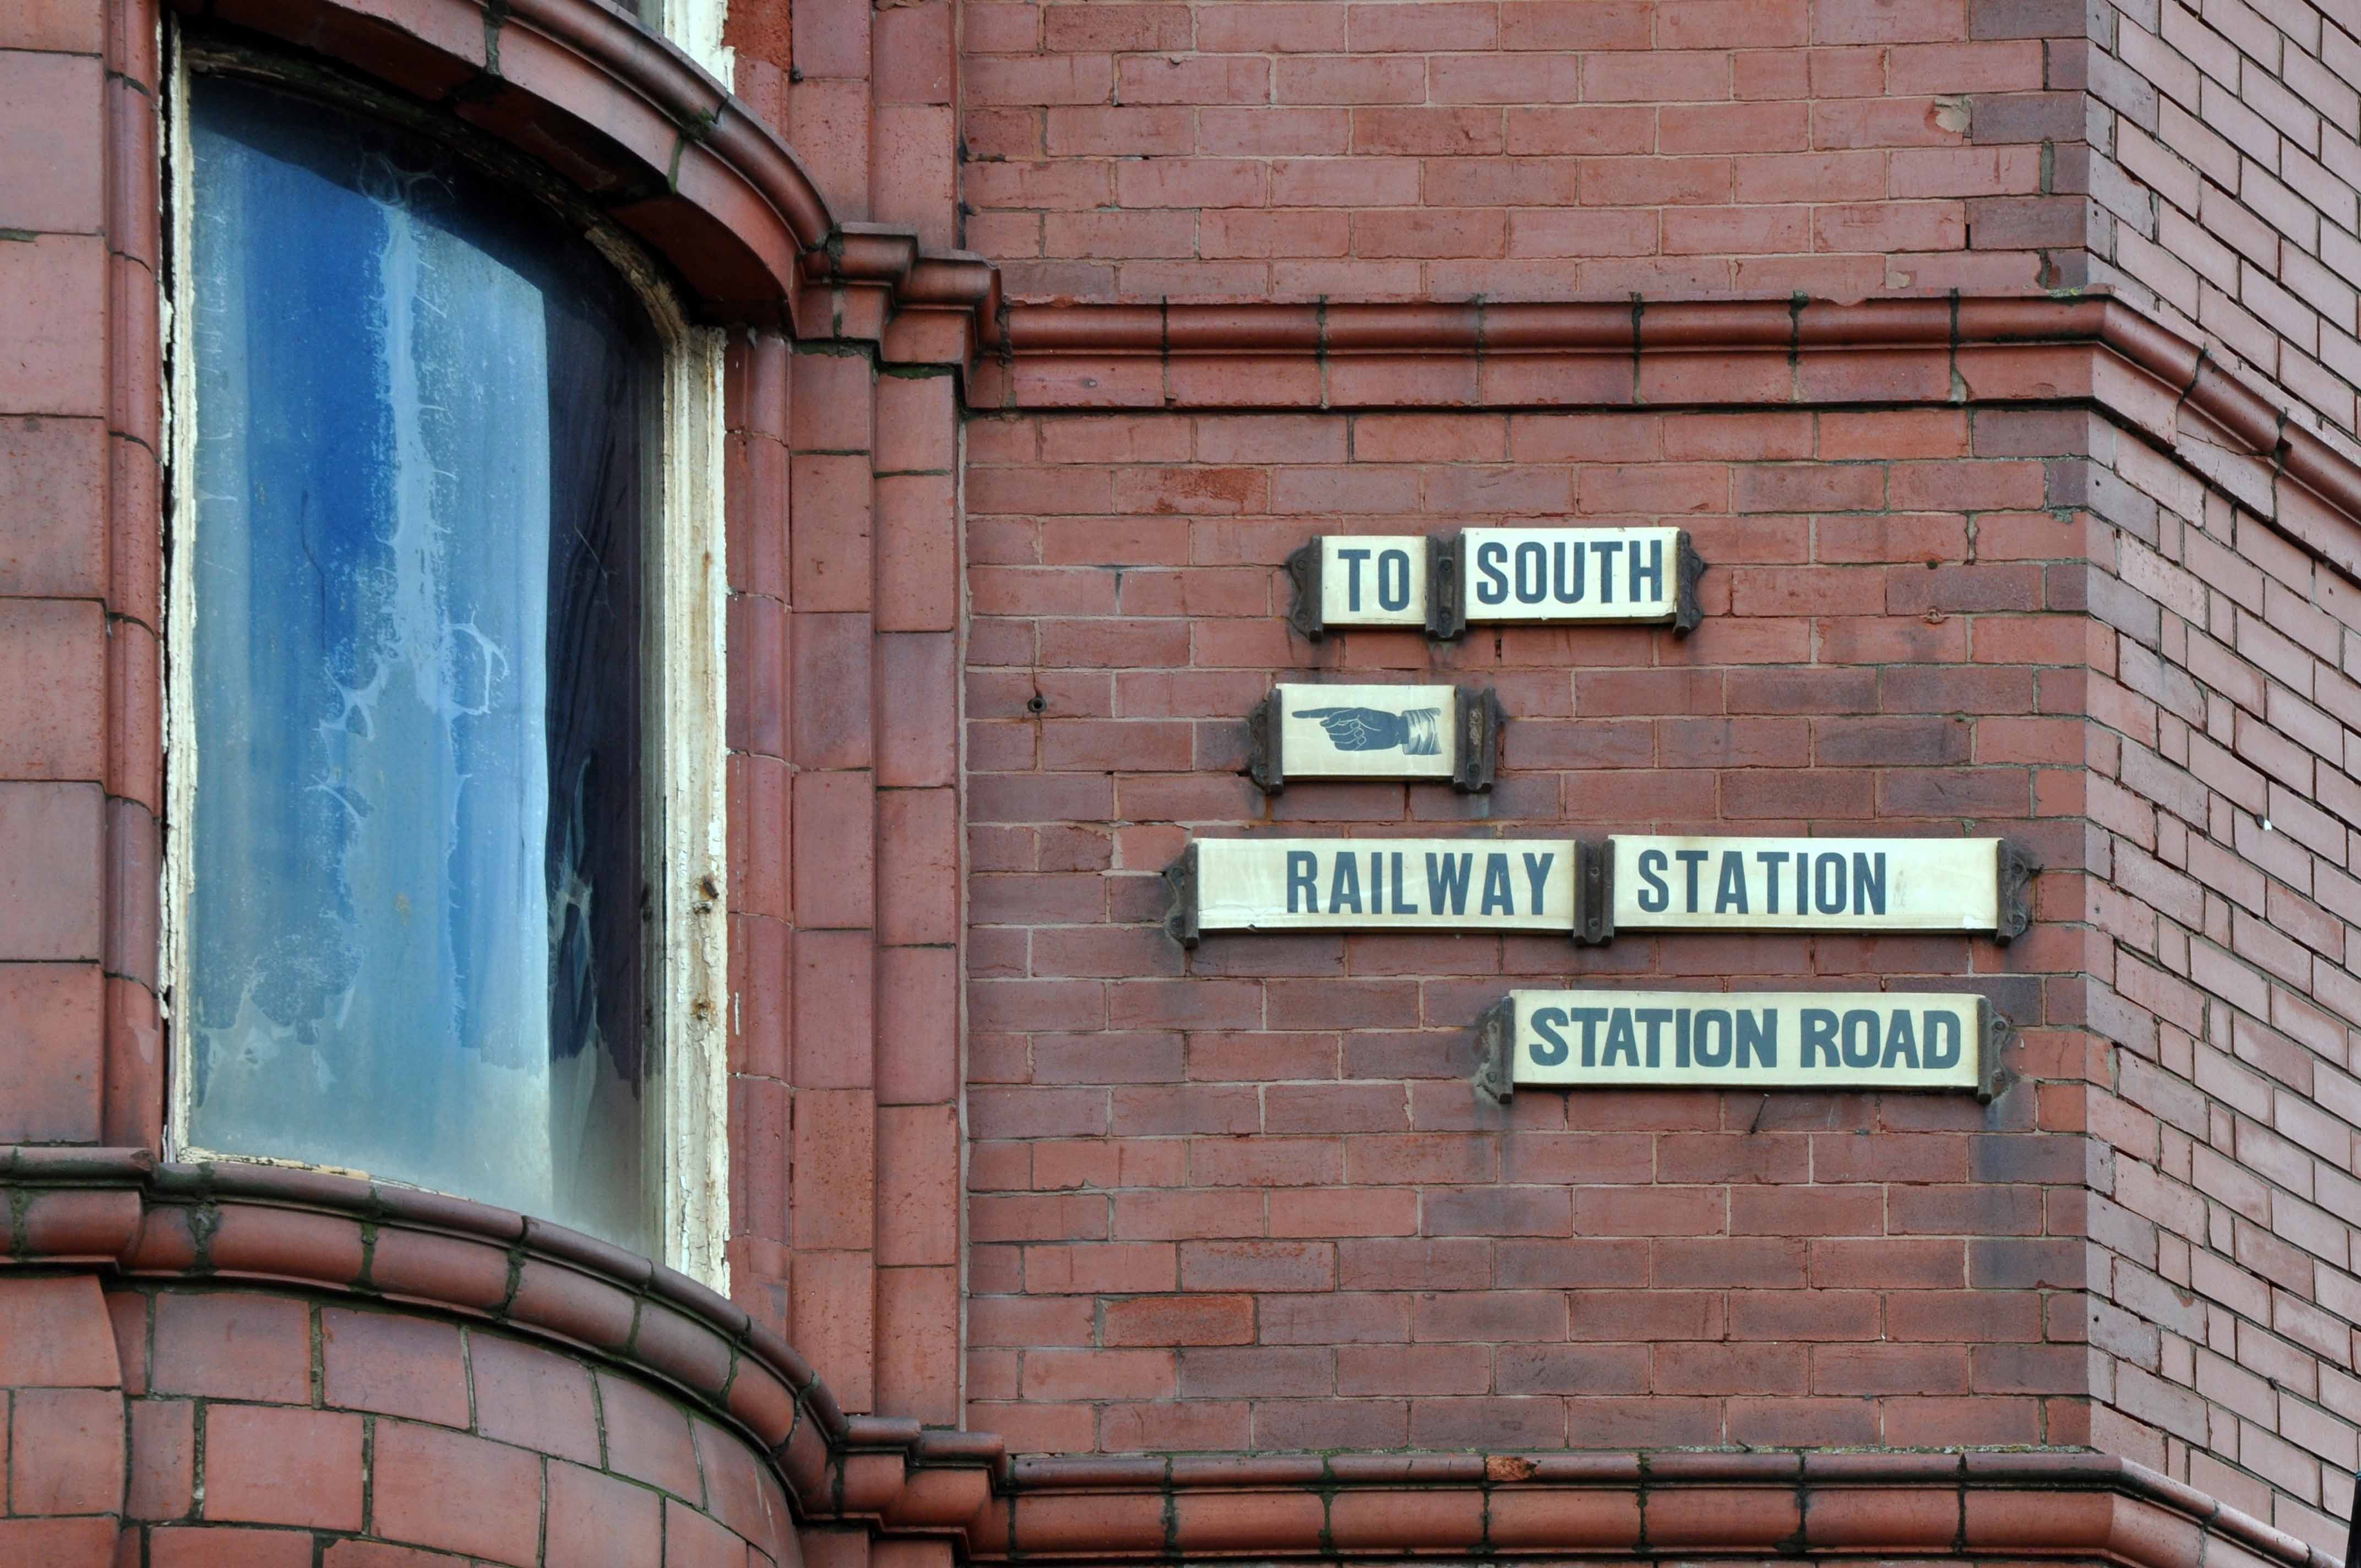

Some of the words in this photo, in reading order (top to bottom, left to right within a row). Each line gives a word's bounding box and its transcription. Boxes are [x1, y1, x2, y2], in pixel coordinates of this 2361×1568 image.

[1338, 549, 1410, 611] TO
[1477, 540, 1662, 605] SOUTH
[1287, 851, 1554, 916] RAILWAY
[1638, 850, 1886, 915] STATION
[1529, 1008, 1777, 1068] STATION
[1800, 1009, 1960, 1069] ROAD
